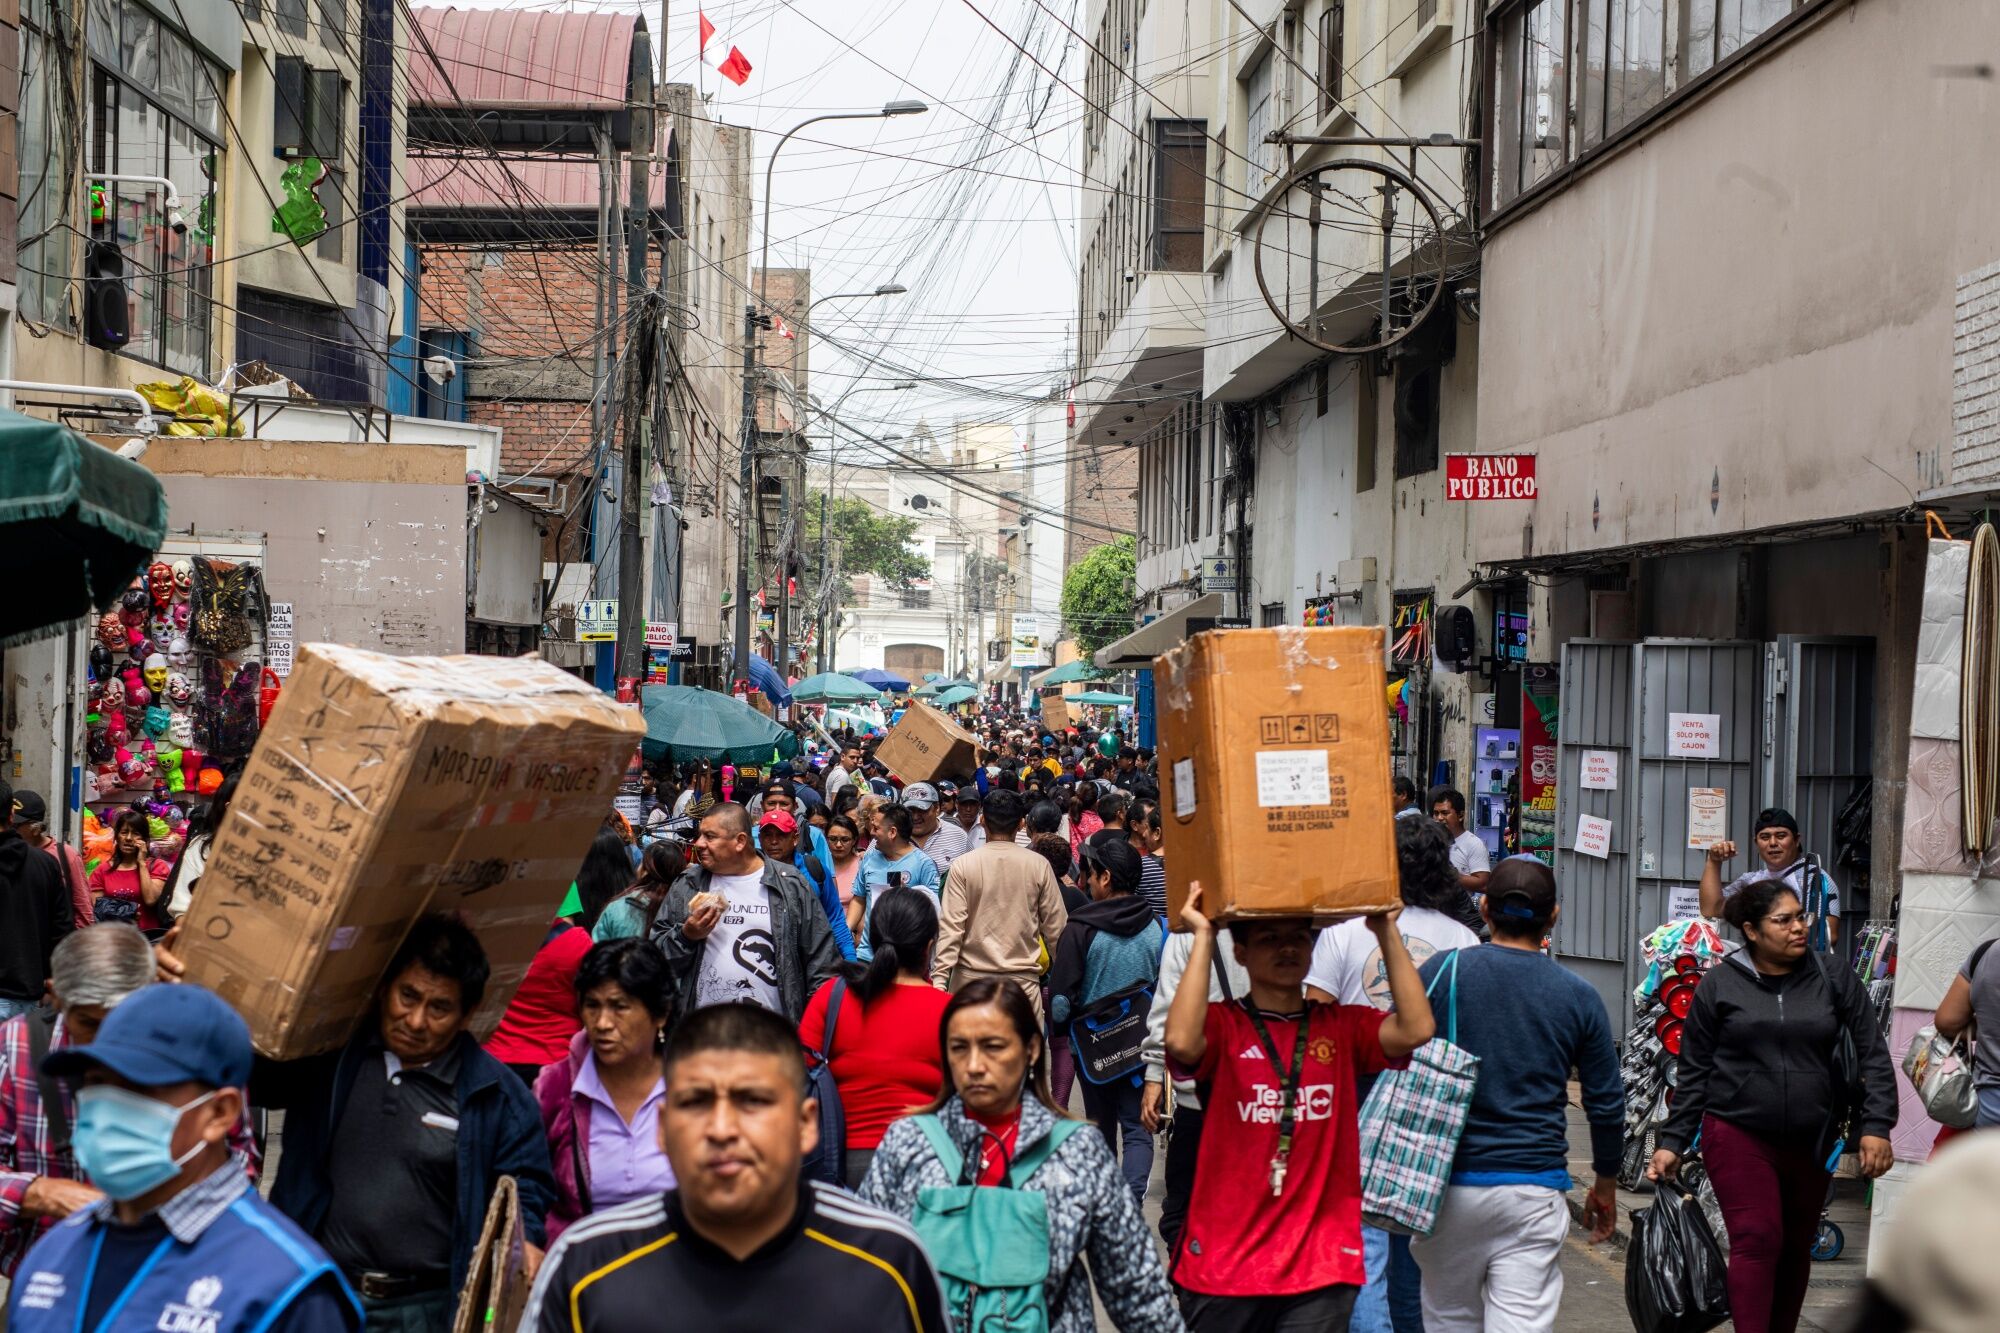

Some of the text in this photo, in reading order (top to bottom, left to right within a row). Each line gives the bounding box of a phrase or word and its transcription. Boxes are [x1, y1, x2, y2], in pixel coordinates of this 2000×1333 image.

[1448, 476, 1535, 498] PUBLICO
[272, 605, 292, 615] UILA
[272, 615, 288, 623] CAL
[645, 633, 673, 641] UBLICO
[671, 648, 692, 656] BBVA
[905, 730, 929, 755] L-7189
[1267, 823, 1293, 833] MADE
[1295, 822, 1305, 832] IN
[732, 904, 769, 915] UNLTD
[725, 916, 743, 925] 1972
[1102, 1051, 1121, 1064] USMP
